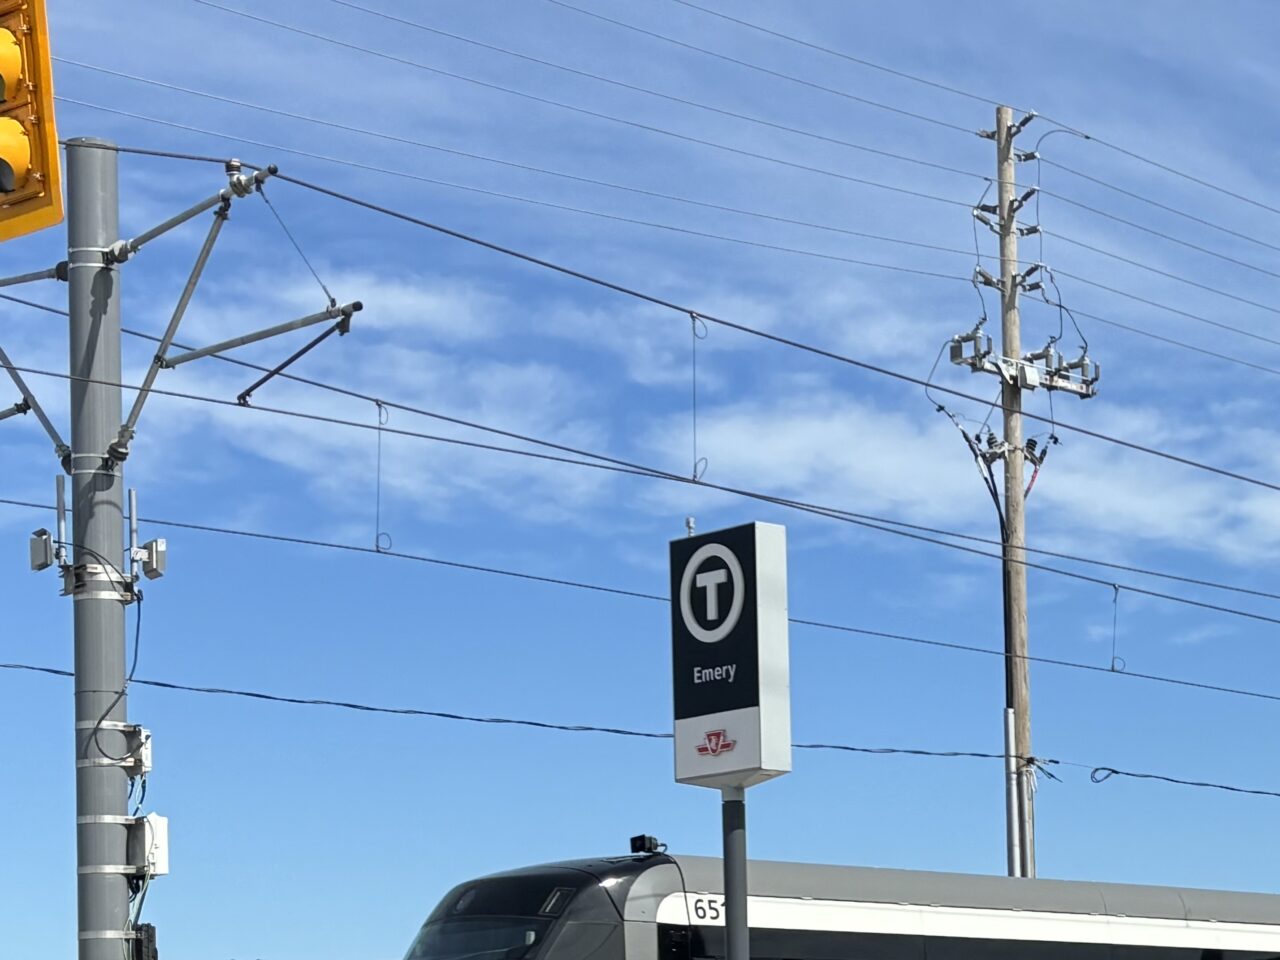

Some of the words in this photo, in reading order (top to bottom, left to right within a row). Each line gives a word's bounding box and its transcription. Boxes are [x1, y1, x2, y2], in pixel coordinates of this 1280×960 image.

[695, 568, 728, 622] T
[693, 663, 737, 684] Emery
[694, 898, 726, 920] 65
